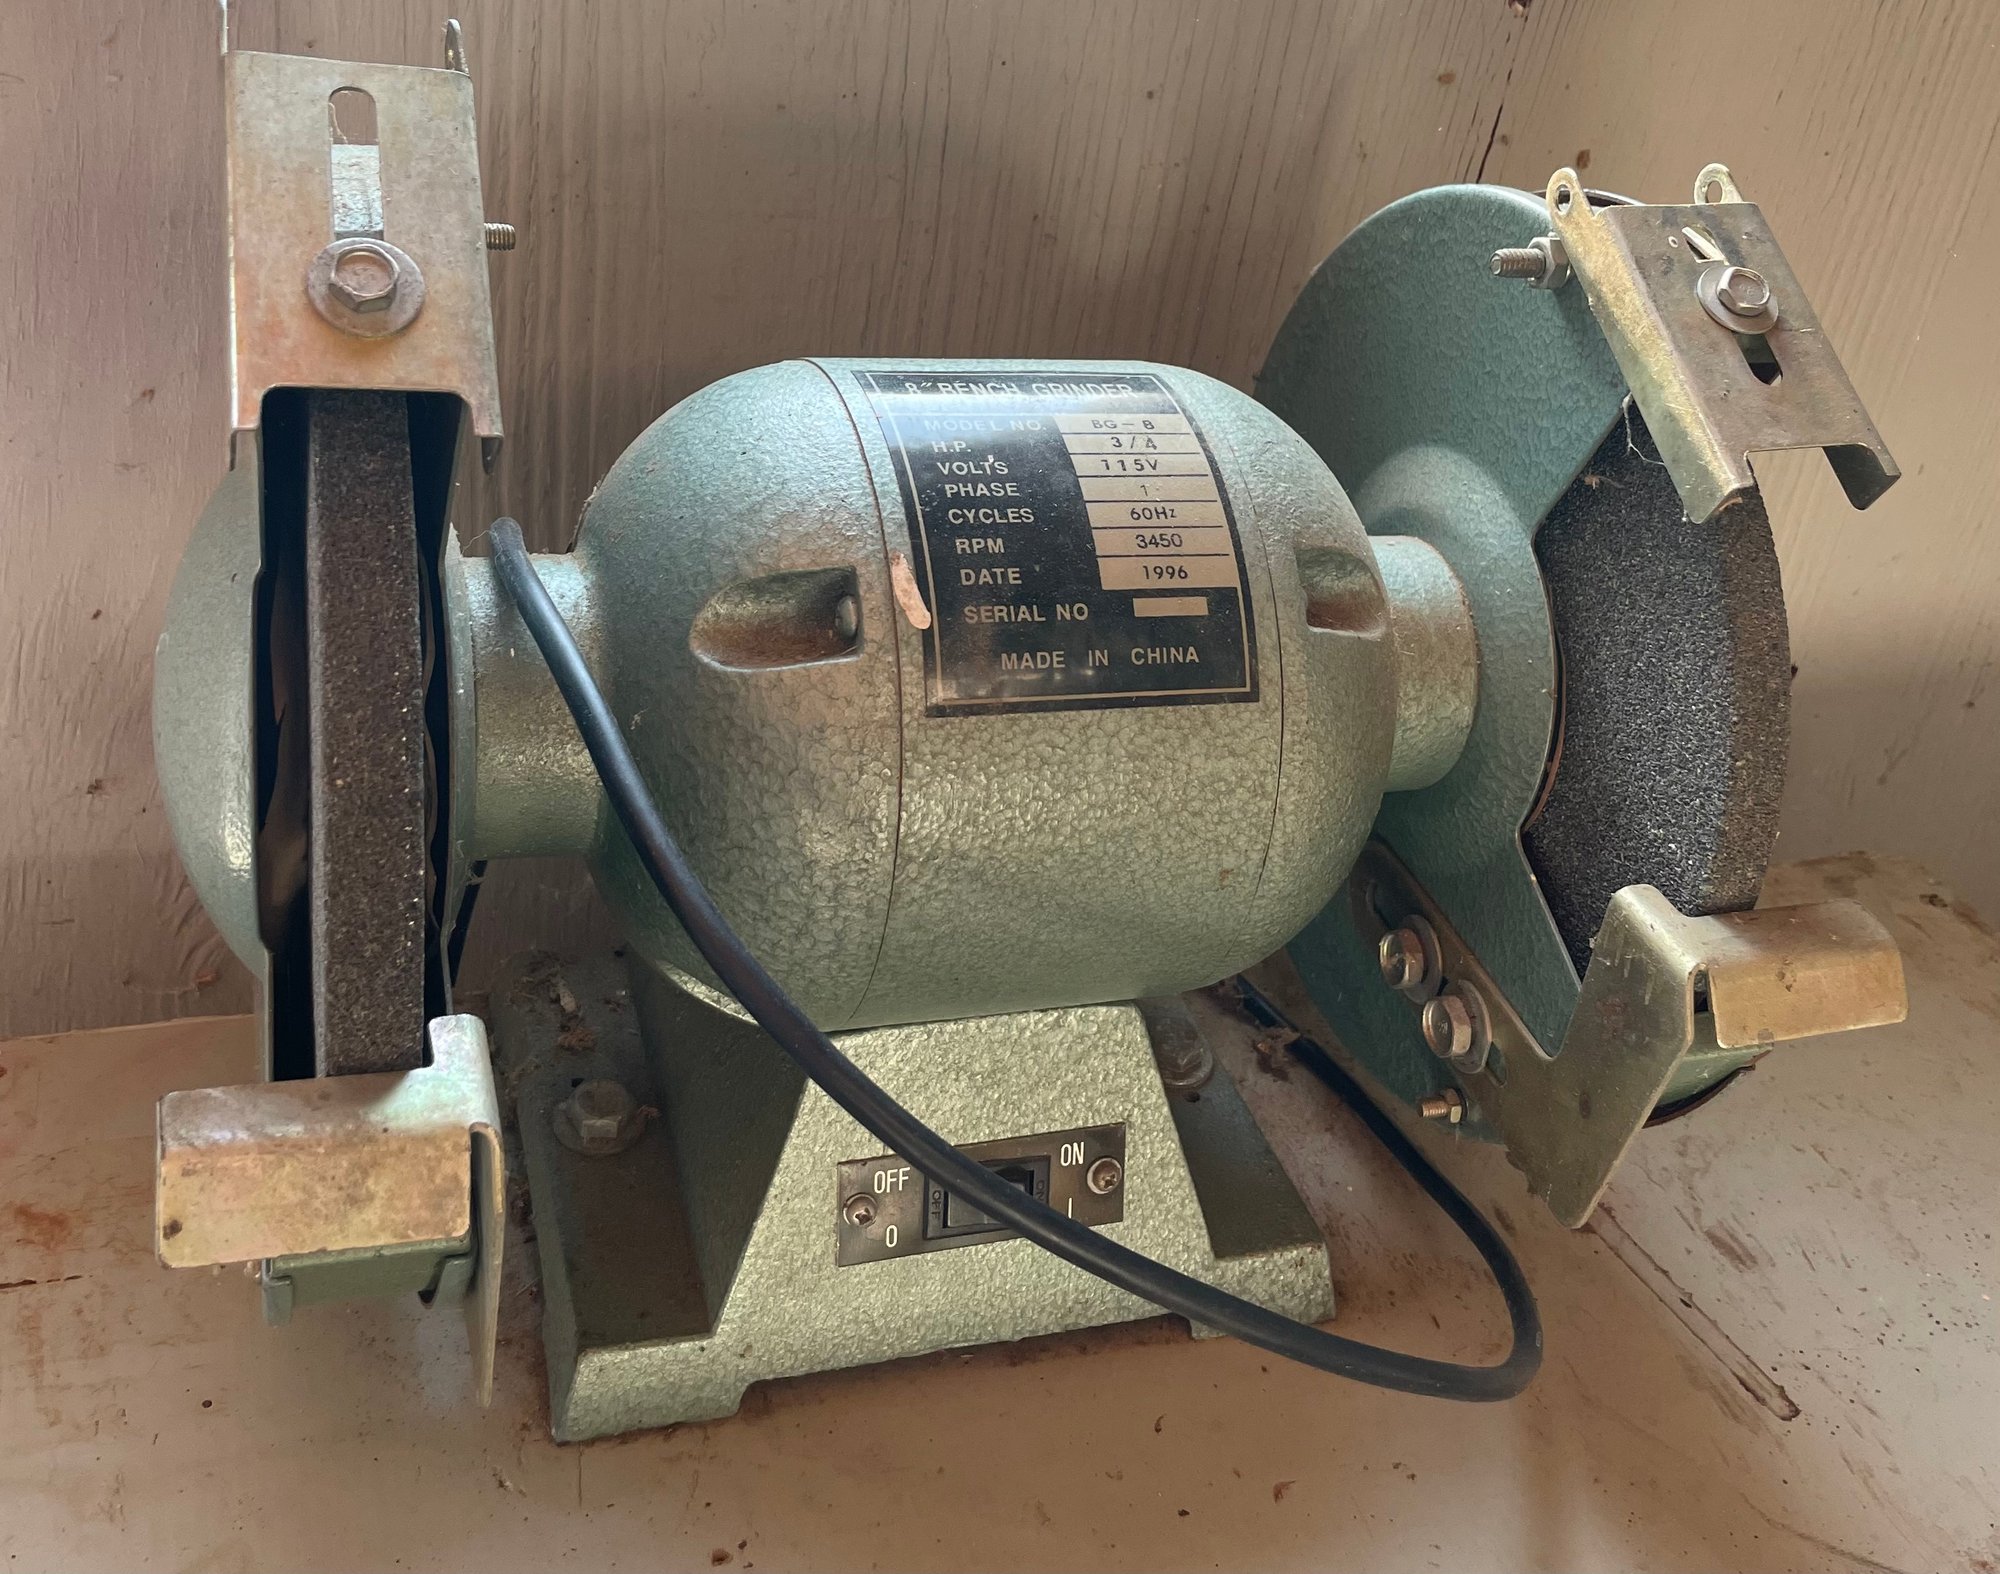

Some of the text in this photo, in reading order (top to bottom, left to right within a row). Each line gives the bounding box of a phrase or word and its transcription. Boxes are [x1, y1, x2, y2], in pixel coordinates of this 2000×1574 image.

[937, 381, 1020, 397] BENCH
[1032, 382, 1138, 398] GRINDER
[924, 419, 1004, 431] MODEL
[1010, 419, 1047, 431] NO.
[931, 440, 971, 452] H.P.
[937, 458, 1158, 475] VOLTS 115V
[945, 482, 1147, 498] PHASE 1
[948, 506, 1177, 524] CYCLES 60Hz
[955, 532, 1183, 554] RPM 3450
[960, 564, 1188, 585] DATE 1996
[964, 603, 1089, 624] SERIAL NO
[1001, 646, 1199, 669] MADE IN CHINA
[1060, 1141, 1085, 1166] ON
[874, 1166, 911, 1194] OFF
